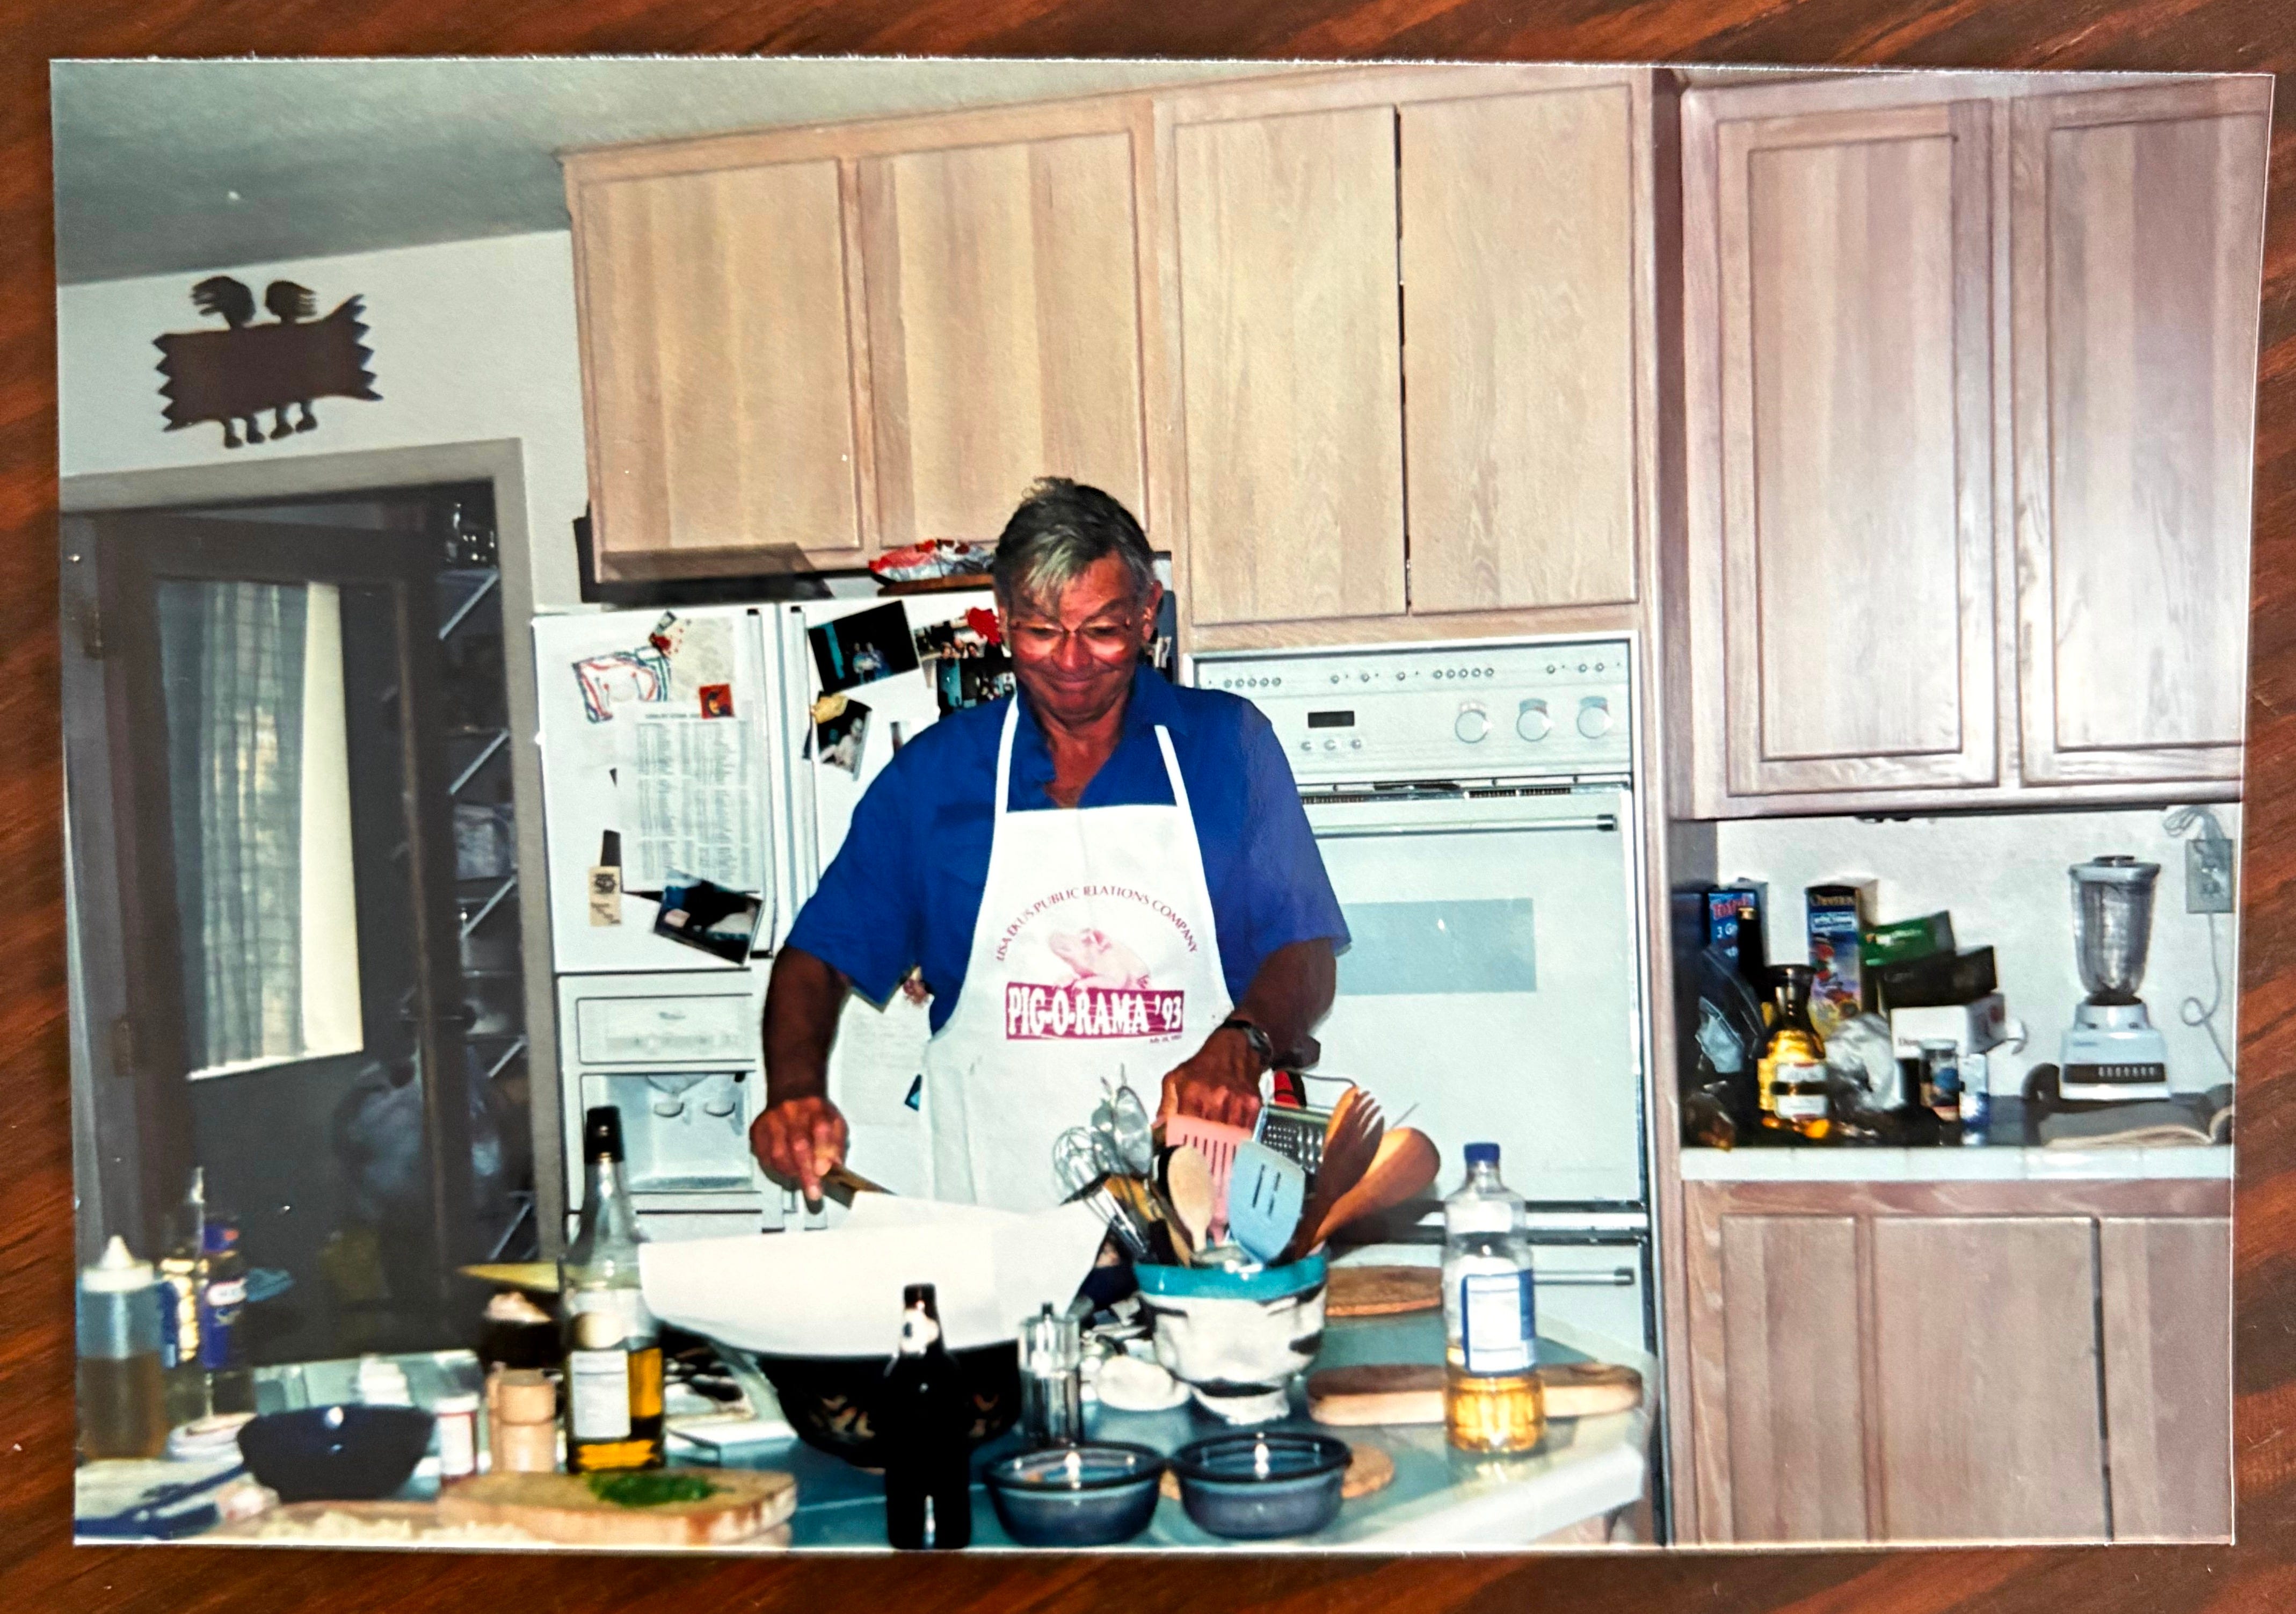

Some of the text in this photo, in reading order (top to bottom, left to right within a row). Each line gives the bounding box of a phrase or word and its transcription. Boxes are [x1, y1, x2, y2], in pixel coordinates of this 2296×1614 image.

[1033, 888, 1079, 913] PUBLIC
[1152, 900, 1197, 952] COMPANY
[1008, 987, 1181, 1036] PIG-O-RAMA '93
